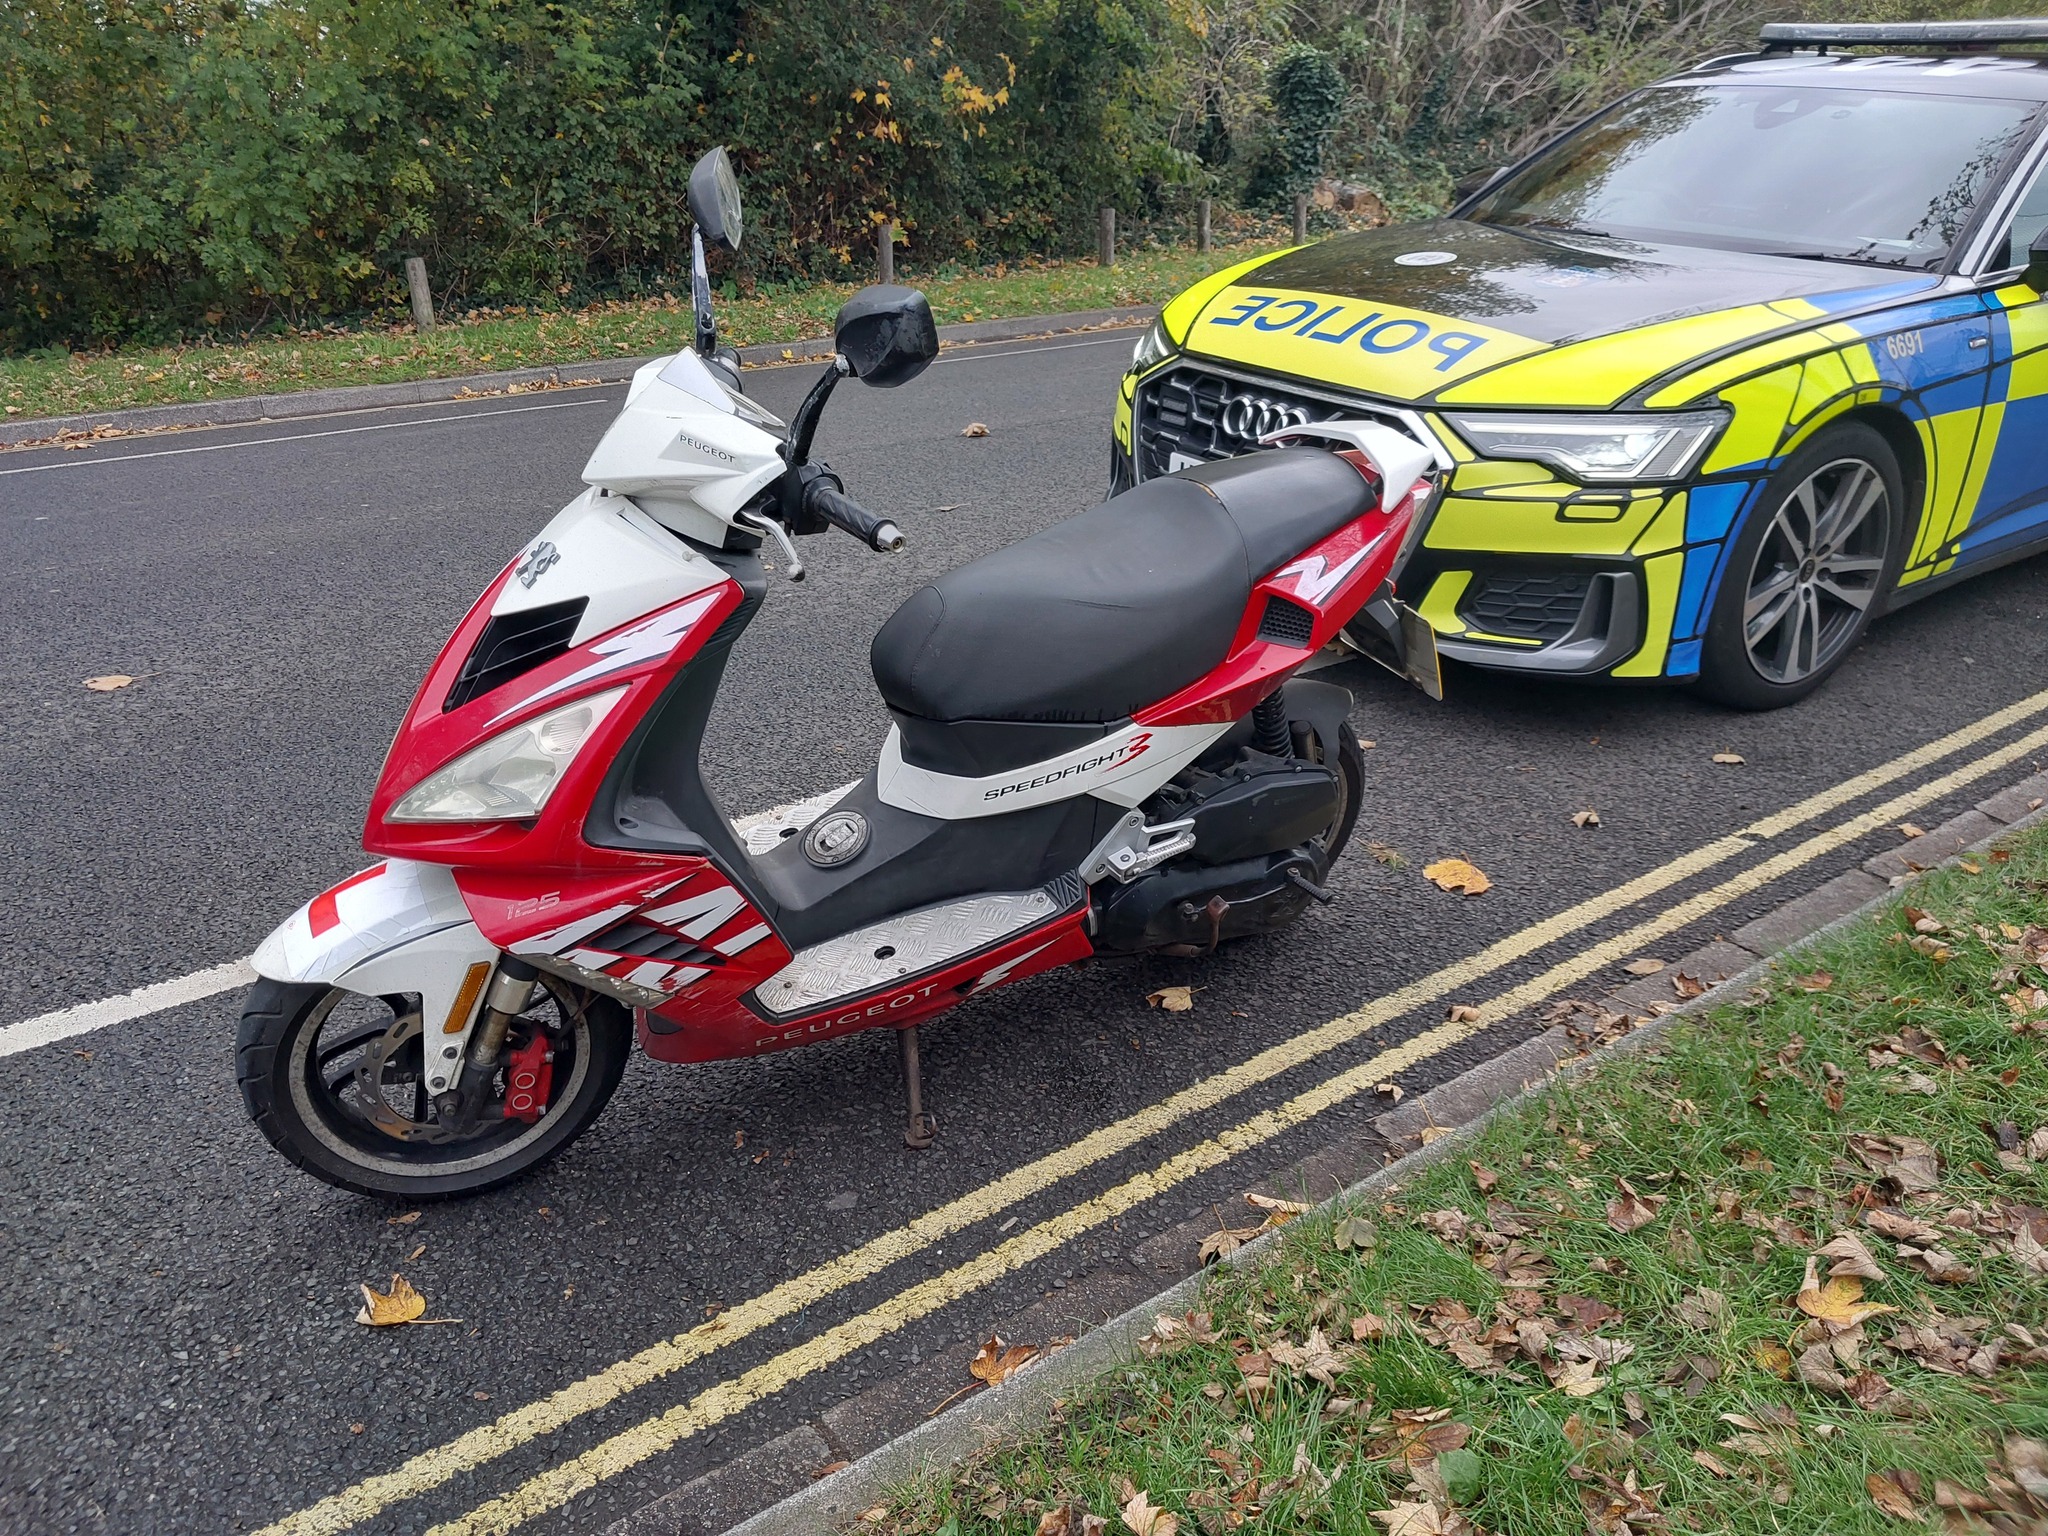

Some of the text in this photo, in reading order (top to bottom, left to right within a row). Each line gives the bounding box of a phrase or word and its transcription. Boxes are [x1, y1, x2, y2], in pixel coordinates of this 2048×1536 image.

[1886, 330, 1924, 360] 6691
[680, 434, 736, 463] PEUGEOT
[983, 746, 1129, 801] SPEEDFIGHT
[507, 891, 561, 920] 125
[755, 983, 939, 1048] PEUGEOT
